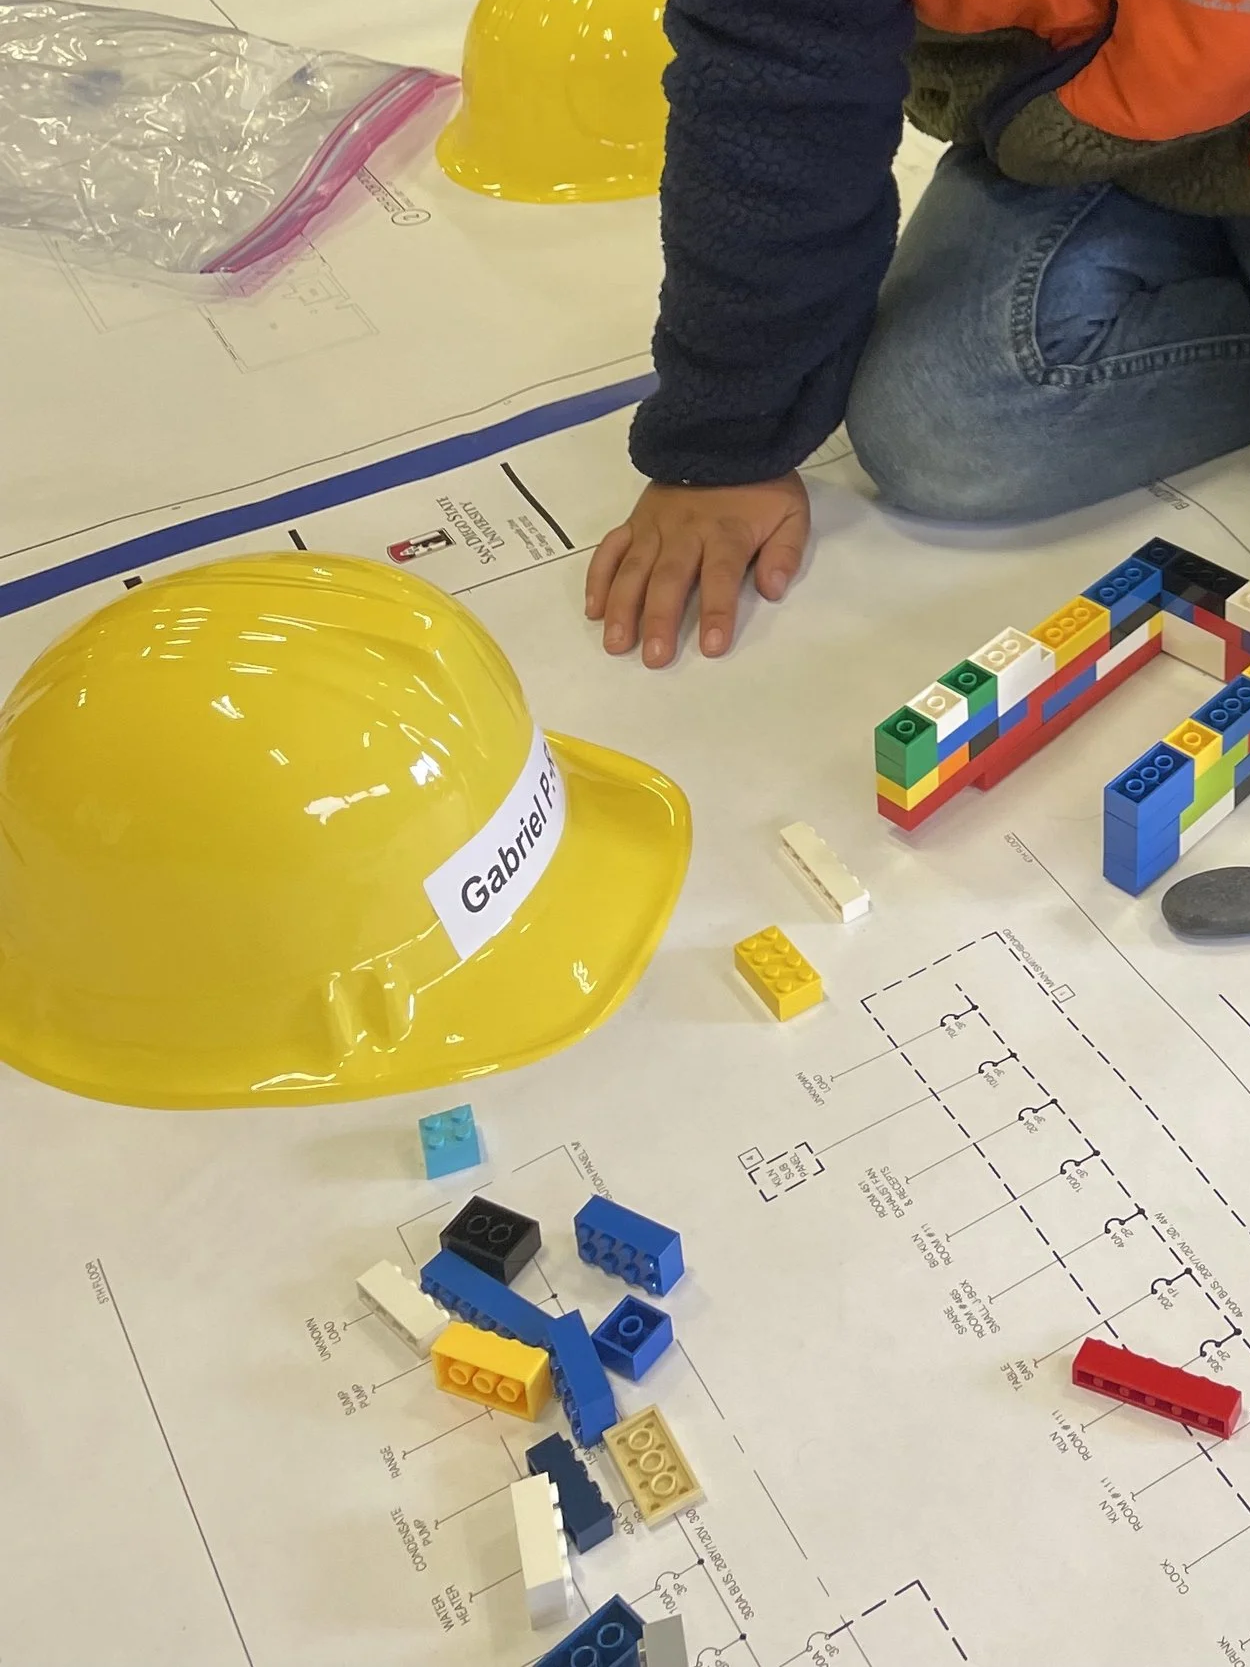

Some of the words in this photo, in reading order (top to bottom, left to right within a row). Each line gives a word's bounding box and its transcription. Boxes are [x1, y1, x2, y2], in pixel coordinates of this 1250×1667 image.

[460, 501, 505, 549] UNIVERSITY
[461, 794, 547, 914] Gabriel
[1003, 833, 1022, 854] FLOOR
[1003, 928, 1042, 972] SWITCHBOARD
[1039, 970, 1054, 989] MAIN
[796, 1072, 825, 1106] UNKNOWN
[813, 1074, 832, 1094] LOAD
[578, 1149, 596, 1175] PANEL
[780, 1162, 795, 1180] SUB
[790, 1152, 808, 1178] PANEL
[768, 1168, 783, 1188] KILN
[858, 1181, 870, 1194] 451
[865, 1167, 880, 1185] FAN
[880, 1165, 909, 1200] RECEPTS
[1066, 1174, 1082, 1193] 100A
[867, 1193, 888, 1218] ROOM
[876, 1184, 905, 1218] EXHAUST
[904, 1198, 914, 1207] &
[1154, 1211, 1168, 1225] 4W
[911, 1233, 928, 1254] KILN
[1110, 1232, 1125, 1248] 40A
[1121, 1227, 1134, 1239] 2P
[924, 1252, 939, 1269] BIG
[931, 1238, 954, 1266] ROOM
[85, 1260, 102, 1290] FLOOR
[95, 1287, 110, 1305] 5TH
[1157, 1291, 1174, 1311] 20A
[1167, 1287, 1180, 1299] 1P
[943, 1306, 967, 1335] SPARE
[979, 1304, 1001, 1334] SMALL
[1225, 1296, 1243, 1319] 400A
[323, 1321, 341, 1345] LOAD
[964, 1310, 987, 1340] ROOM
[305, 1317, 331, 1362] UNKNOWN
[1207, 1355, 1223, 1373] 30A
[1217, 1349, 1231, 1362] 2P
[1000, 1362, 1023, 1392] TABLE
[1015, 1360, 1034, 1381] SAW
[337, 1390, 356, 1416] SUMP
[351, 1383, 371, 1409] PUMP
[1050, 1431, 1069, 1454] KILN
[1066, 1431, 1092, 1461] ROOM
[380, 1445, 401, 1479] RANGE
[1099, 1500, 1120, 1524] KILN
[1117, 1499, 1144, 1531] ROOM
[413, 1518, 433, 1547] PUMP
[621, 1516, 635, 1535] 40A
[391, 1506, 428, 1572] CONDENSATE
[673, 1582, 687, 1596] 3P
[1160, 1558, 1190, 1595] CLOCK
[431, 1594, 455, 1633] WATER
[445, 1584, 471, 1626] HEATER
[659, 1588, 678, 1614] 100A
[735, 1594, 754, 1621] 300A
[1216, 1635, 1245, 1667] DRINK
